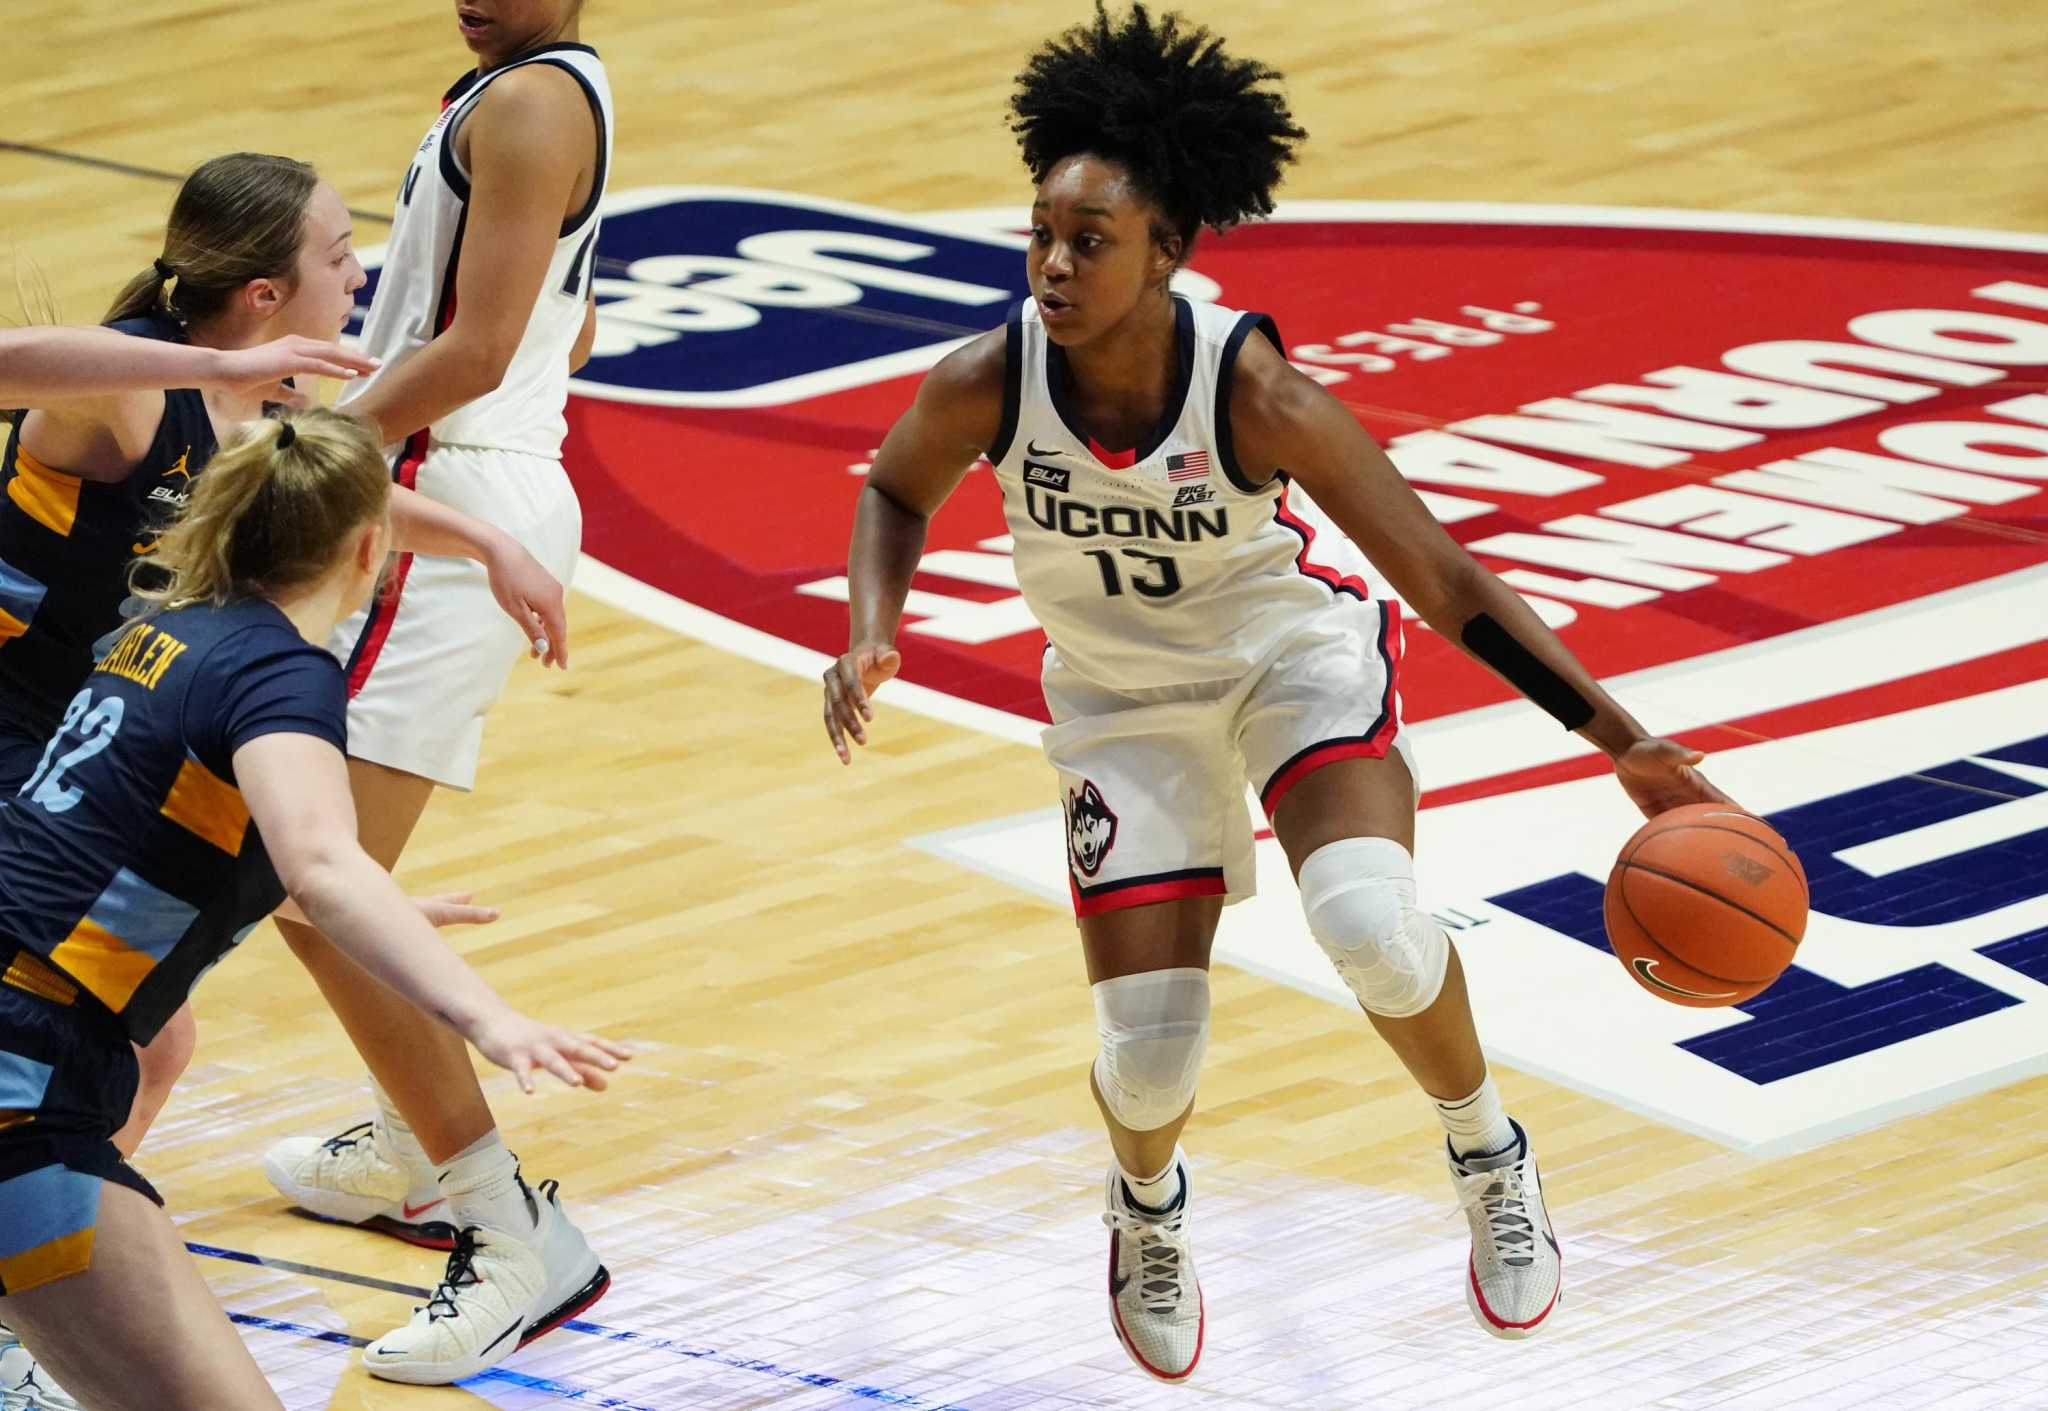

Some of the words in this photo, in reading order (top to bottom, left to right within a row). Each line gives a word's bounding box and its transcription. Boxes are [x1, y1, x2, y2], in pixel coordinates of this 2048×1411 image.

[1028, 467, 1066, 486] BLM
[1172, 490, 1217, 507] EAST
[1177, 483, 1208, 495] BIG
[1024, 484, 1229, 543] UCONN
[1082, 548, 1184, 598] 13
